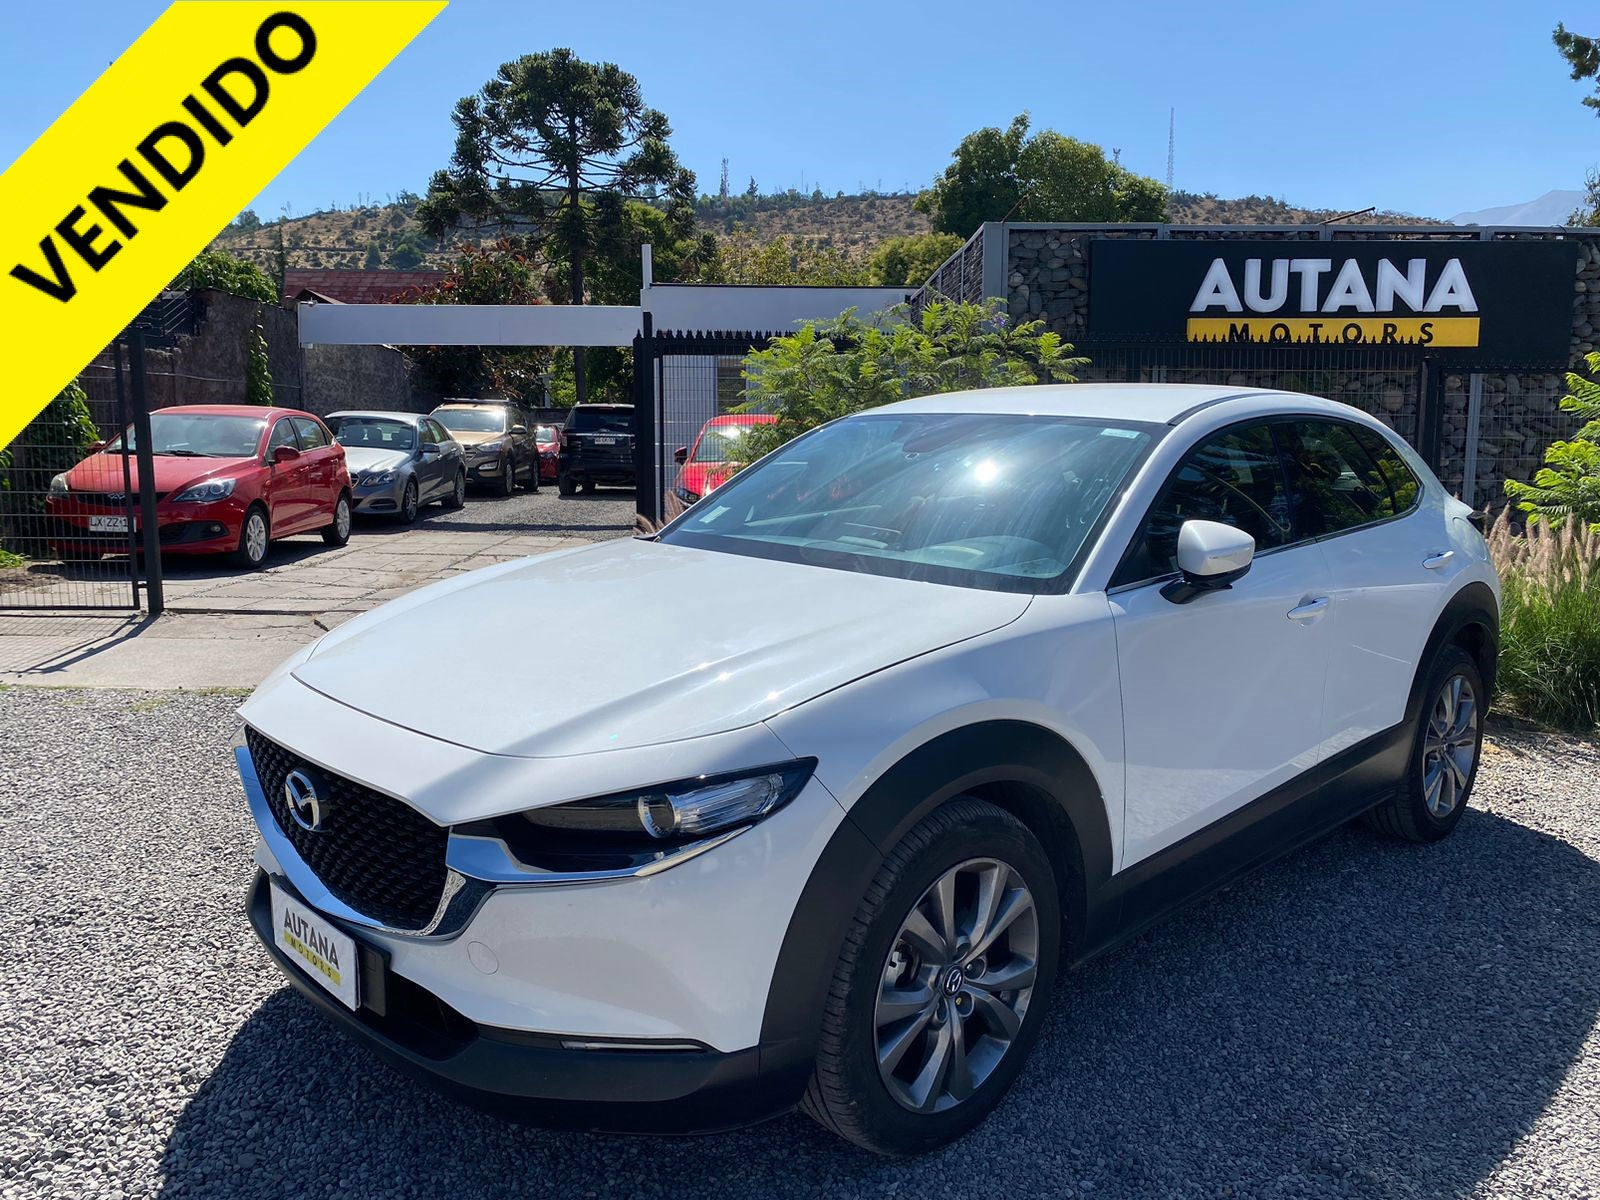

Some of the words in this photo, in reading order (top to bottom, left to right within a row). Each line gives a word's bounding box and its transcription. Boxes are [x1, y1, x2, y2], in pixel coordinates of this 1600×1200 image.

[1189, 257, 1479, 313] AUTANA
[1229, 322, 1434, 344] MOTORS
[284, 907, 339, 970] AUTANA
[290, 937, 332, 977] MOTORS
